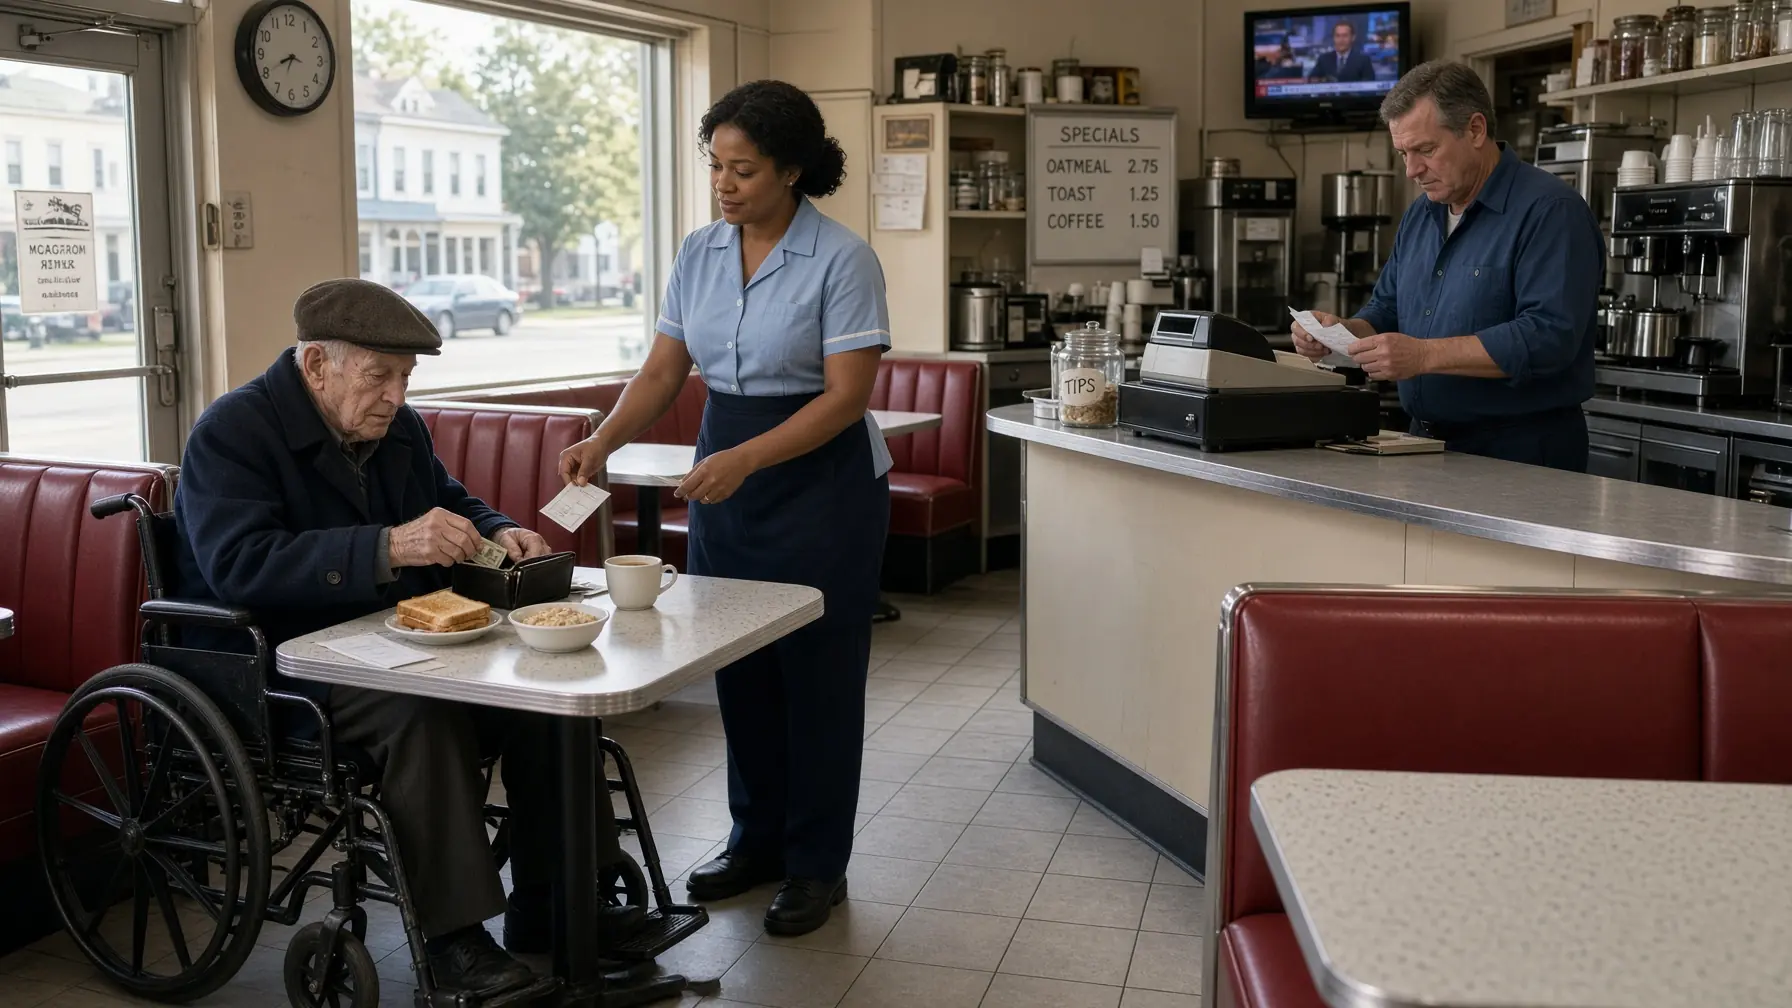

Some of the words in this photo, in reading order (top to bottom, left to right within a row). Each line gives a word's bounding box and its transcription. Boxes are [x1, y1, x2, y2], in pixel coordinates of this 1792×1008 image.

[271, 17, 279, 29] 11
[284, 13, 295, 27] 12
[260, 30, 271, 43] 10
[311, 36, 318, 48] 2
[257, 47, 264, 60] 9
[316, 55, 323, 68] 3
[262, 66, 269, 79] 8
[312, 73, 318, 84] 4
[274, 82, 280, 93] 7
[303, 85, 309, 98] 5
[288, 88, 295, 101] 6
[1060, 126, 1140, 143] SPECIALS
[1046, 158, 1112, 174] OATMEAL
[1128, 158, 1158, 174] 2.75
[1047, 186, 1096, 202] TOAST
[1130, 186, 1159, 201] 1.25
[1047, 213, 1104, 229] COFFEE
[1130, 213, 1160, 228] 1.50
[1064, 377, 1095, 394] TIPS
